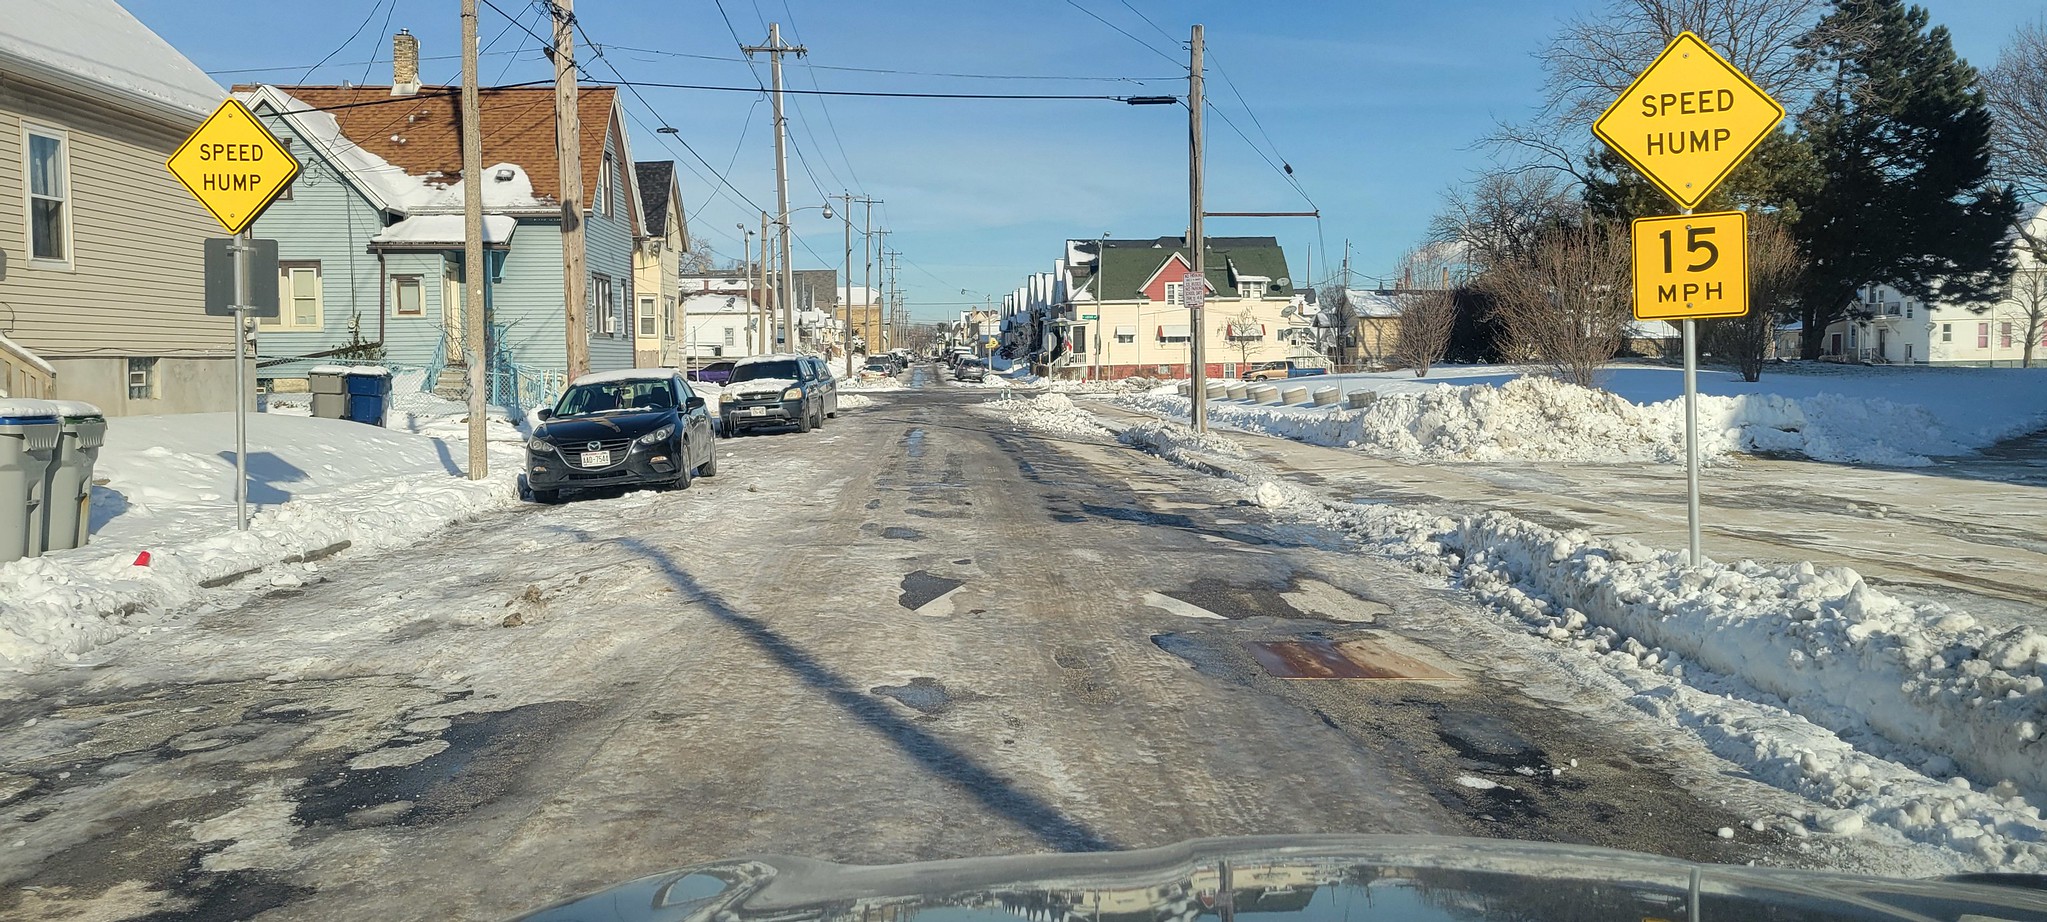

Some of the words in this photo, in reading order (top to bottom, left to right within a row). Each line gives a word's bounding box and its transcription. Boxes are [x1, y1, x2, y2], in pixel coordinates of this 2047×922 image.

[1641, 89, 1735, 118] SPEED
[200, 143, 263, 161] SPEED
[1647, 128, 1731, 156] HUMP
[203, 173, 261, 191] HUMP
[1659, 226, 1719, 274] 15
[1658, 281, 1723, 303] MPH
